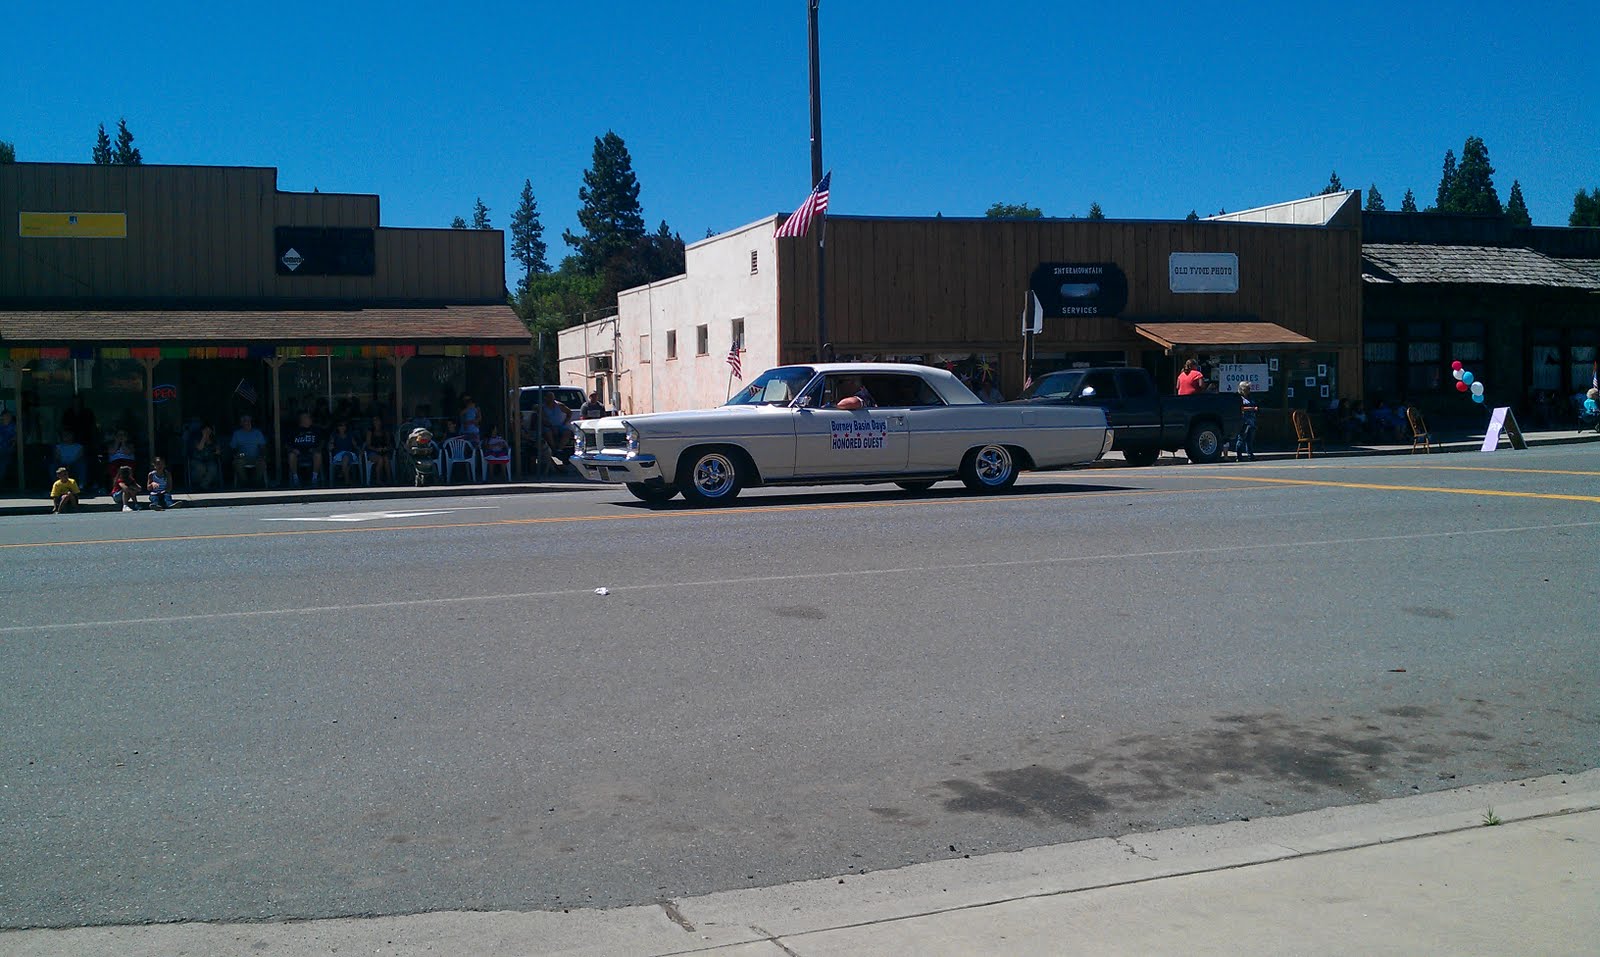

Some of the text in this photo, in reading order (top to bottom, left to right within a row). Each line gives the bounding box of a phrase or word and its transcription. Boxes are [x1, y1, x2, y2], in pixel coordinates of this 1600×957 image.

[1054, 267, 1103, 275] INTERMOUNTAIN
[1174, 267, 1188, 275] OLD
[1211, 267, 1232, 275] PHOTO
[1062, 306, 1097, 314] SERVICES
[1226, 374, 1259, 382] GOODIES
[831, 420, 886, 433] Burney Basin Days
[832, 437, 883, 449] HONORED GUEST
